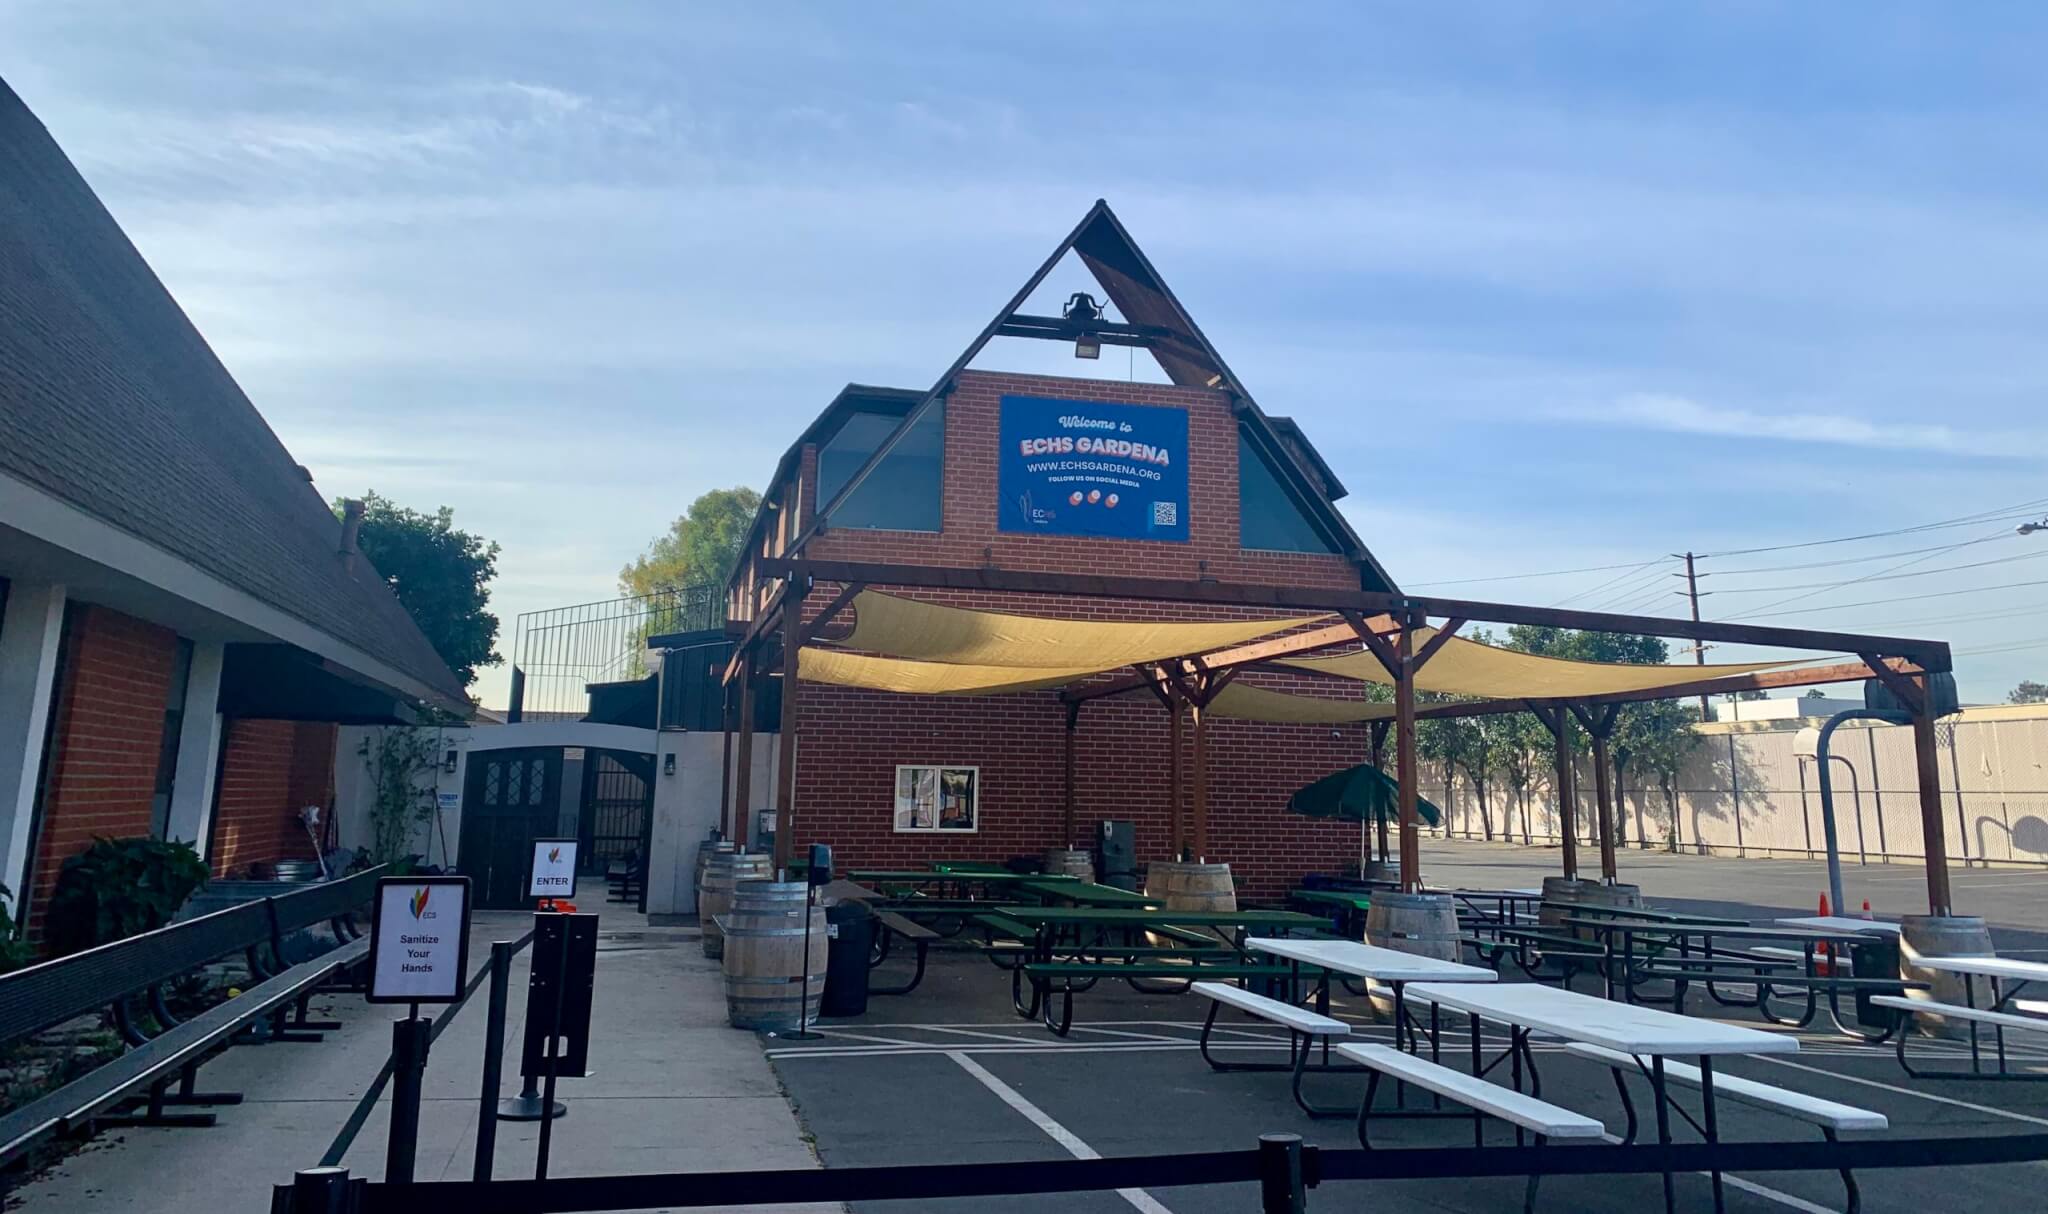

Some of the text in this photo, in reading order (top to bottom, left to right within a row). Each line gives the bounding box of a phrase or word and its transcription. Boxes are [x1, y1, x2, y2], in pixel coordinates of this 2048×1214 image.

[1058, 415, 1133, 433] Welcome to
[1021, 436, 1170, 467] ECHS GARDENA
[1026, 461, 1161, 481] WWW.ECHSGARDENA.ORG
[1048, 475, 1075, 483] FOLLOW
[1096, 476, 1119, 485] SOCIAL
[1119, 479, 1140, 489] MEDIA
[536, 877, 569, 886] ENTER
[422, 911, 437, 919] ECS
[400, 934, 439, 944] Sanitize
[407, 949, 431, 958] Your
[401, 963, 433, 973] Hands
